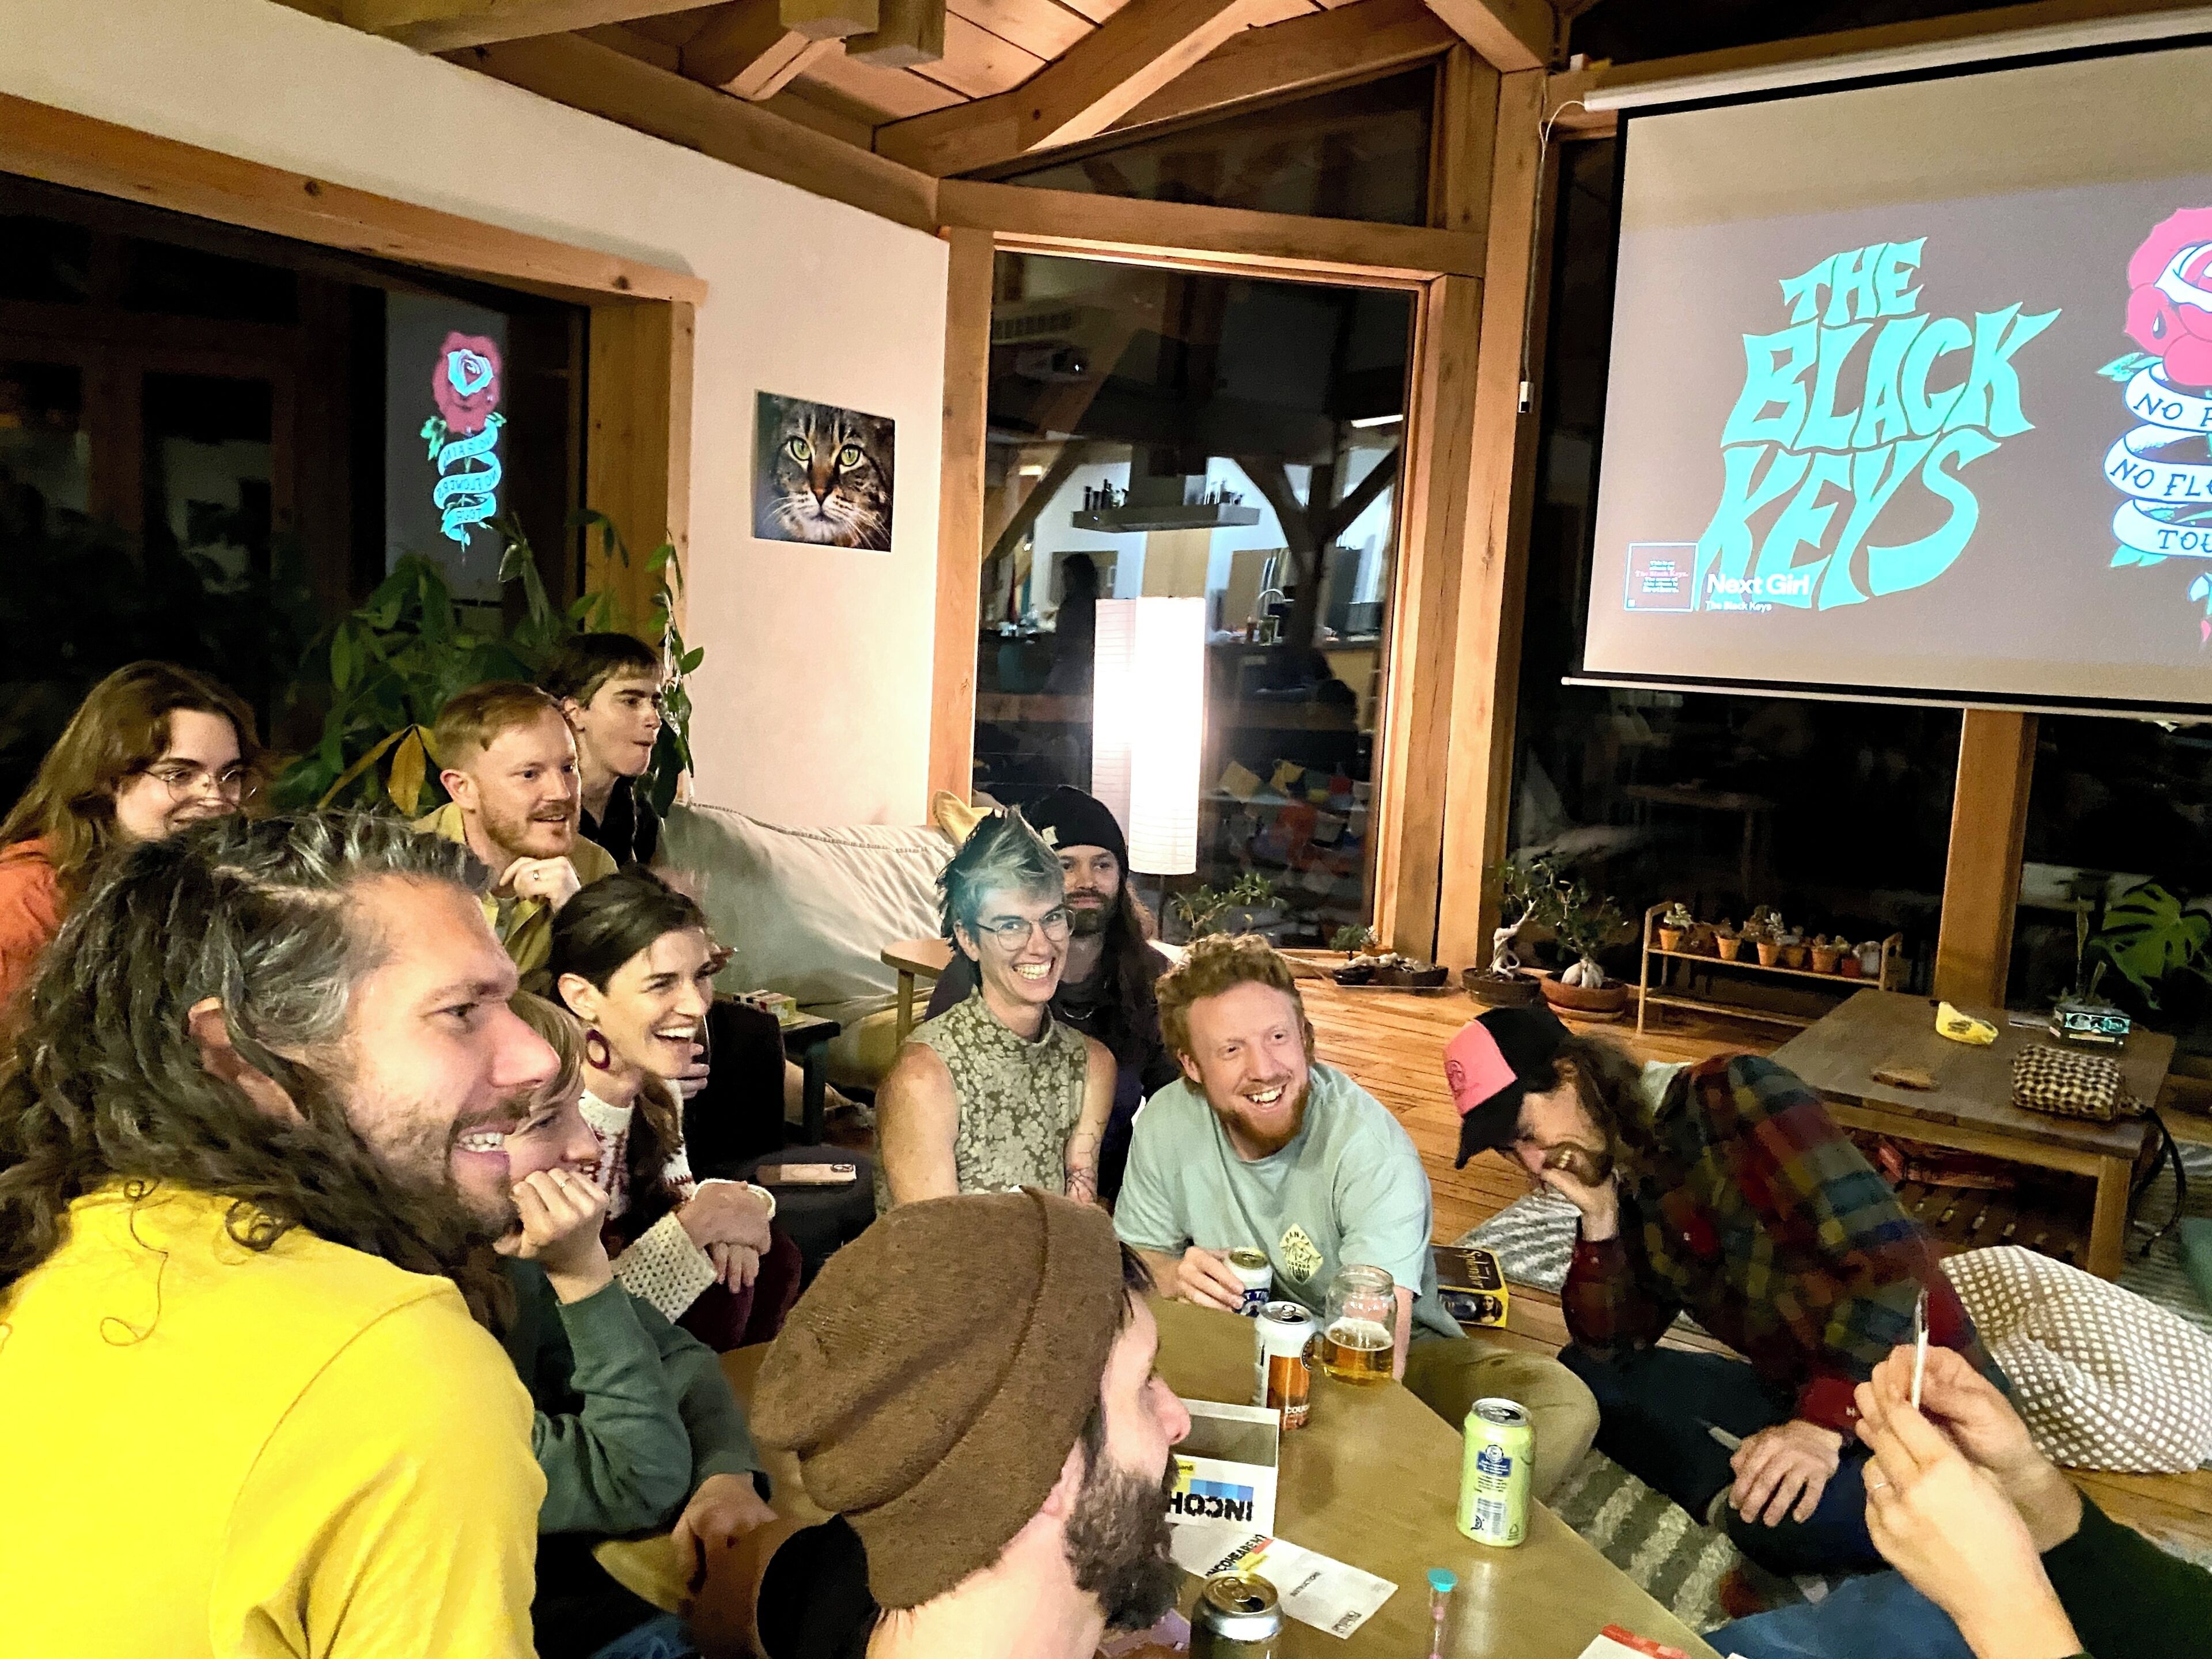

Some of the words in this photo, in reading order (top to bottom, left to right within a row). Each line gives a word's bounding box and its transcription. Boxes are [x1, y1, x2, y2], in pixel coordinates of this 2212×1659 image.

[1779, 237, 1927, 325] THE
[1721, 302, 2062, 450] BLACK
[2133, 393, 2183, 421] NO
[2110, 459, 2155, 489] NO
[1694, 430, 2001, 611] KEYS
[2158, 529, 2212, 554] TOU
[1707, 573, 1763, 594] Next
[1767, 573, 1810, 595] Girl
[1723, 600, 1748, 611] Black
[1749, 601, 1772, 613] Keys
[1455, 1251, 1489, 1288] Splendor
[1170, 1491, 1253, 1522] INCOH
